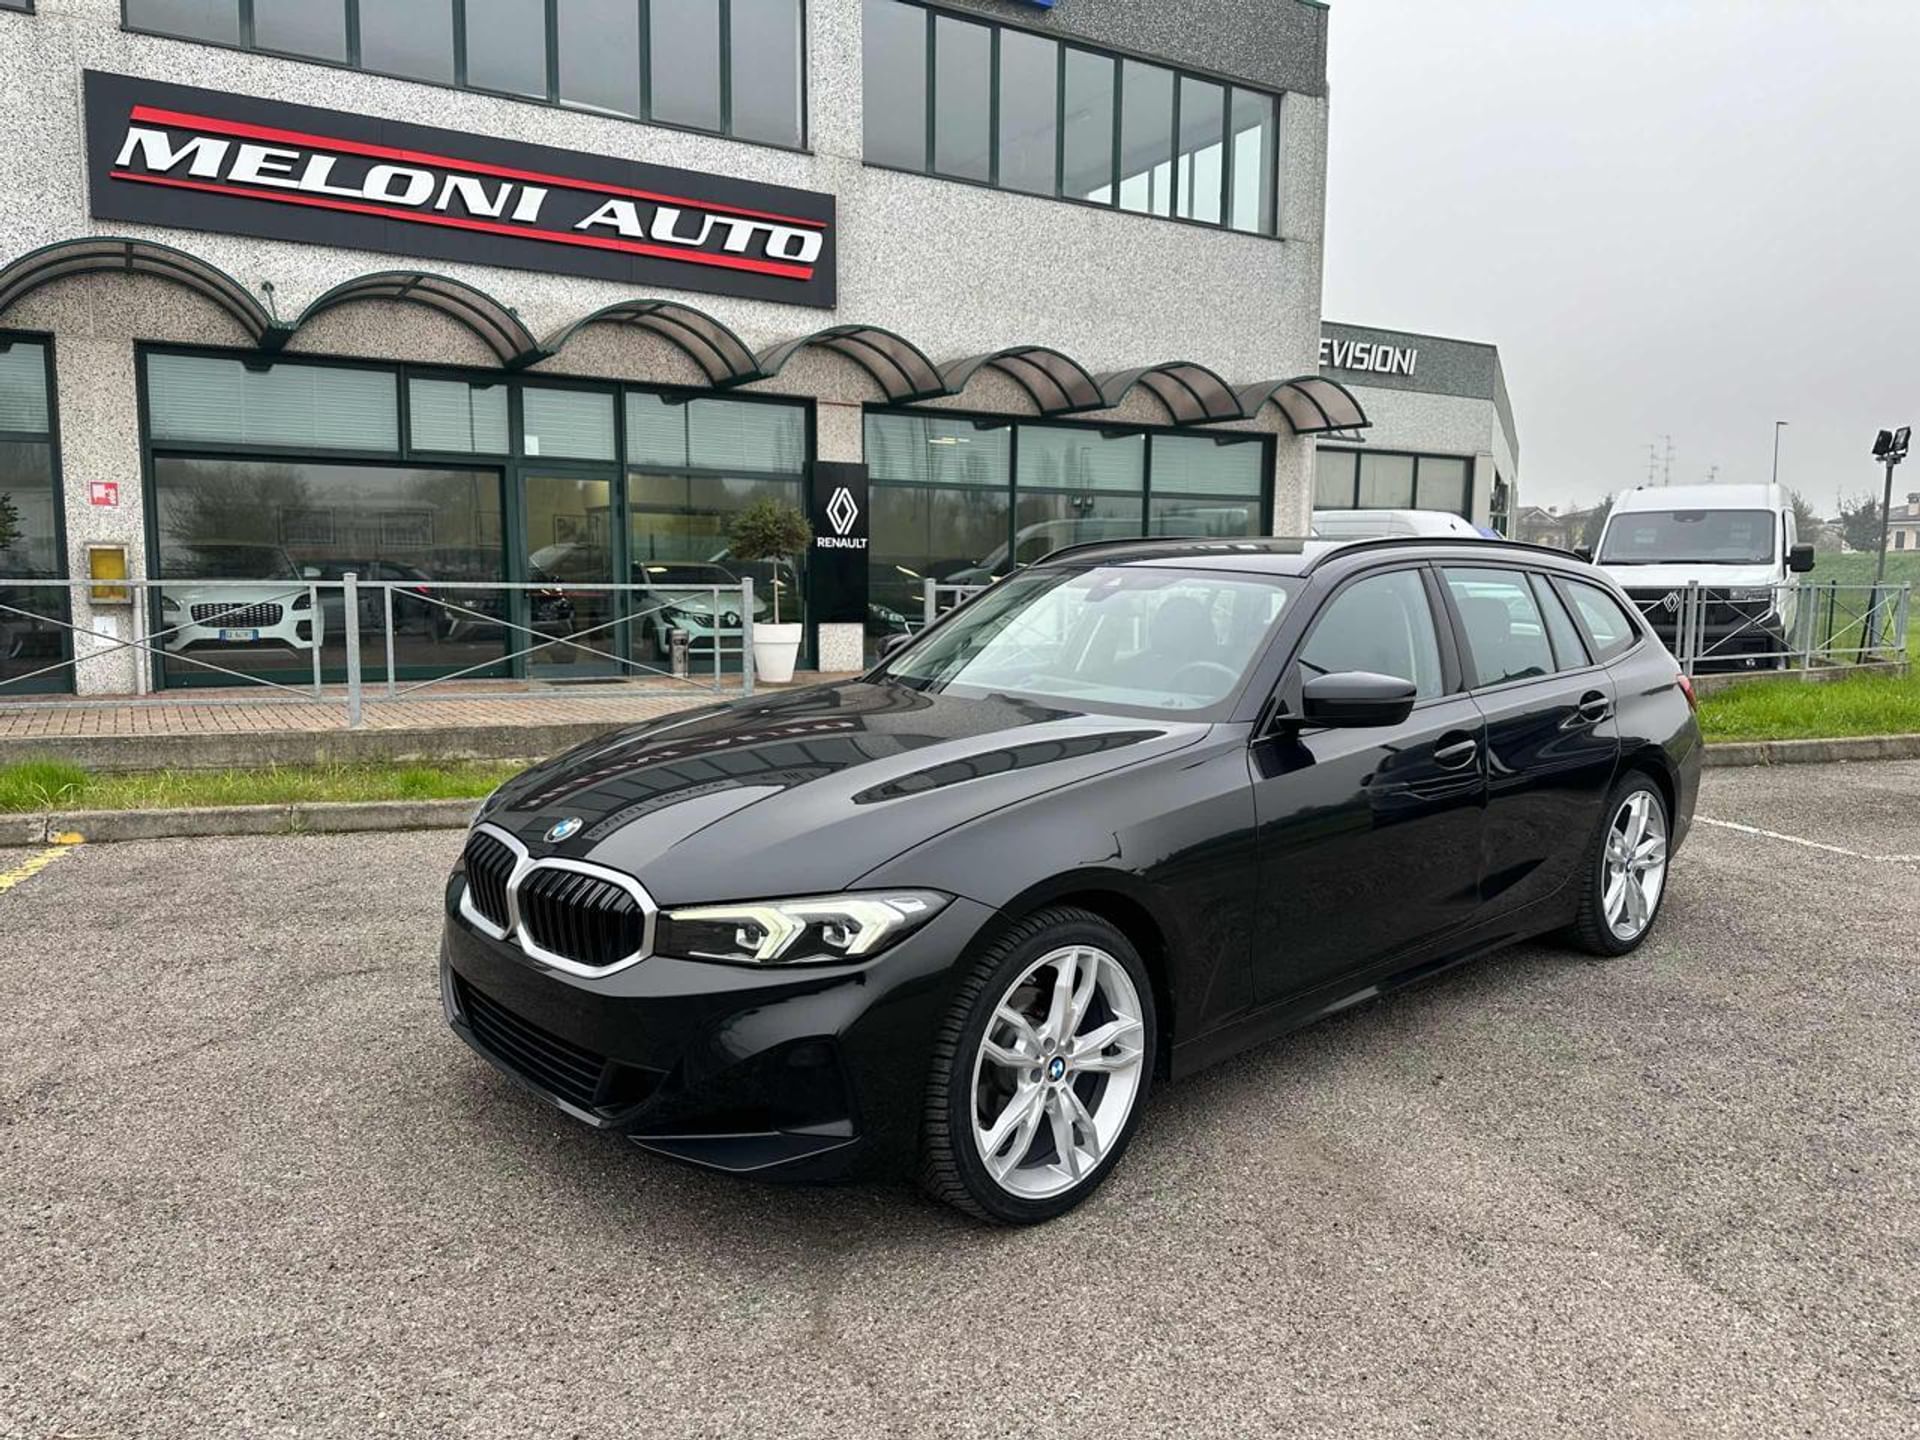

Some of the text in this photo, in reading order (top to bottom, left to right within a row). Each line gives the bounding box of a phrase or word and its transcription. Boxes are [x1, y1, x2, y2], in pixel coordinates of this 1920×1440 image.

[114, 127, 825, 264] MELONI AUTO
[1318, 337, 1418, 375] EVISIONI
[816, 536, 868, 549] RENAULT
